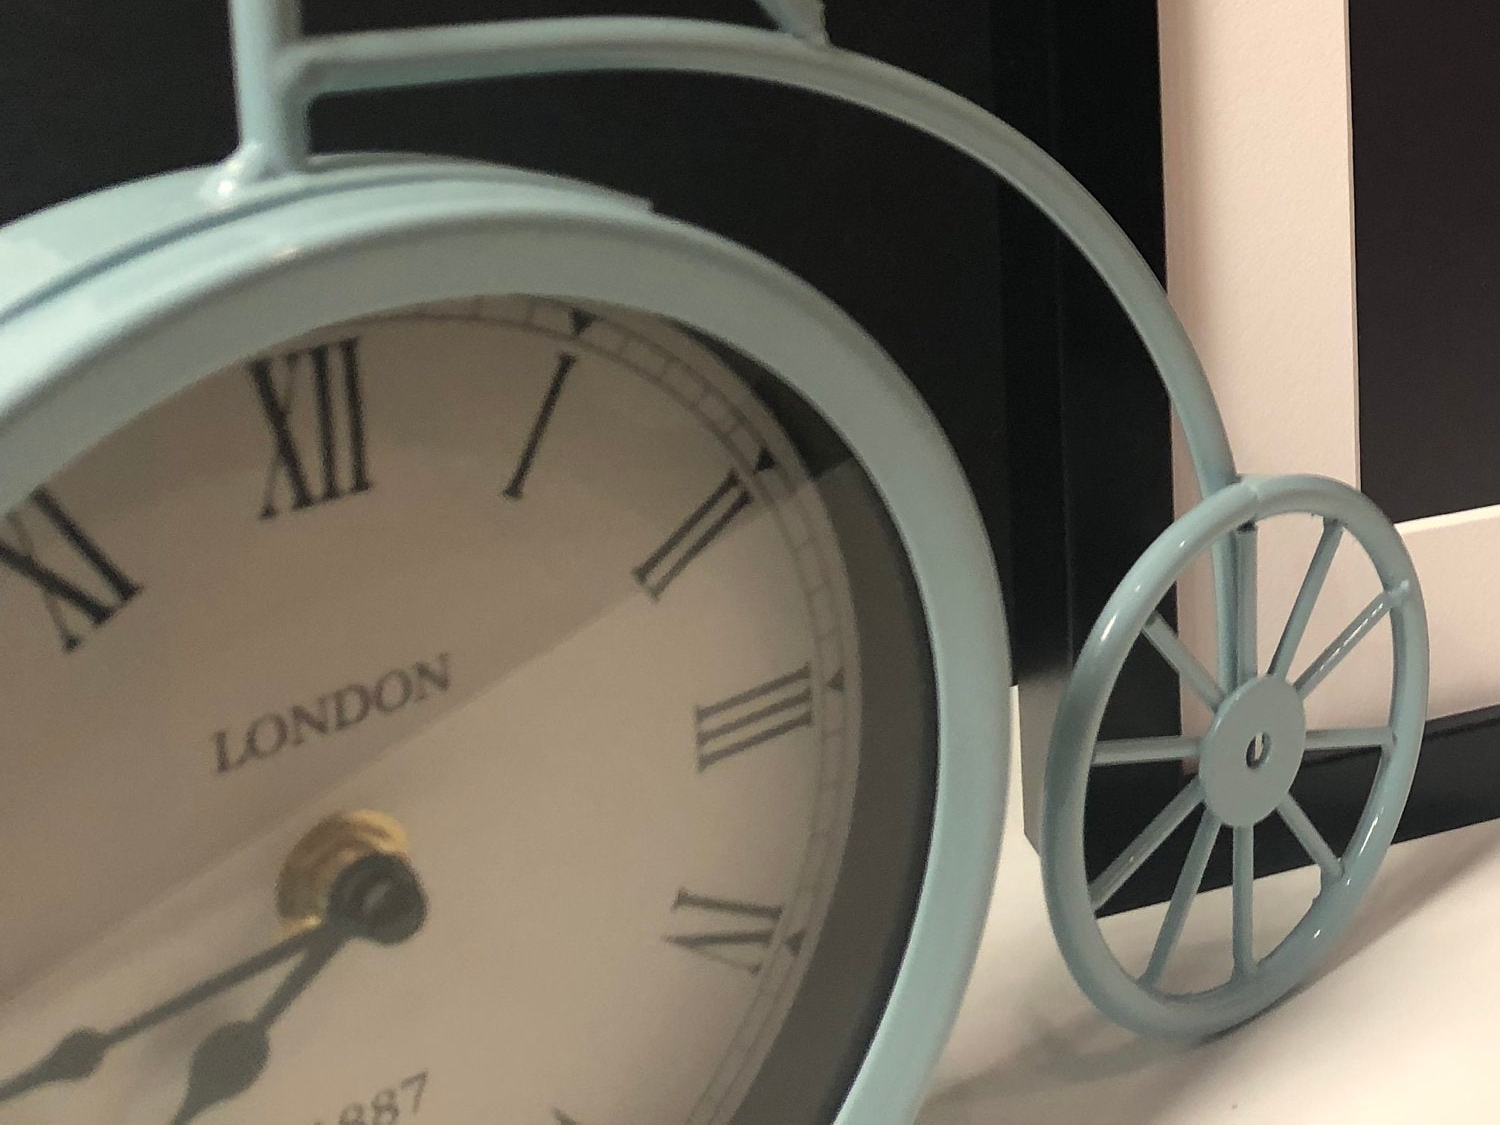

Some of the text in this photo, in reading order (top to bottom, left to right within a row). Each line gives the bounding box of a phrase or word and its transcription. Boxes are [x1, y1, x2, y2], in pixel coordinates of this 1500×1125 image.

[246, 336, 371, 520] XII
[0, 485, 144, 653] XI
[633, 468, 752, 601] II
[210, 652, 454, 772] LONDON
[693, 664, 814, 772] III
[313, 1070, 429, 1125] 887
